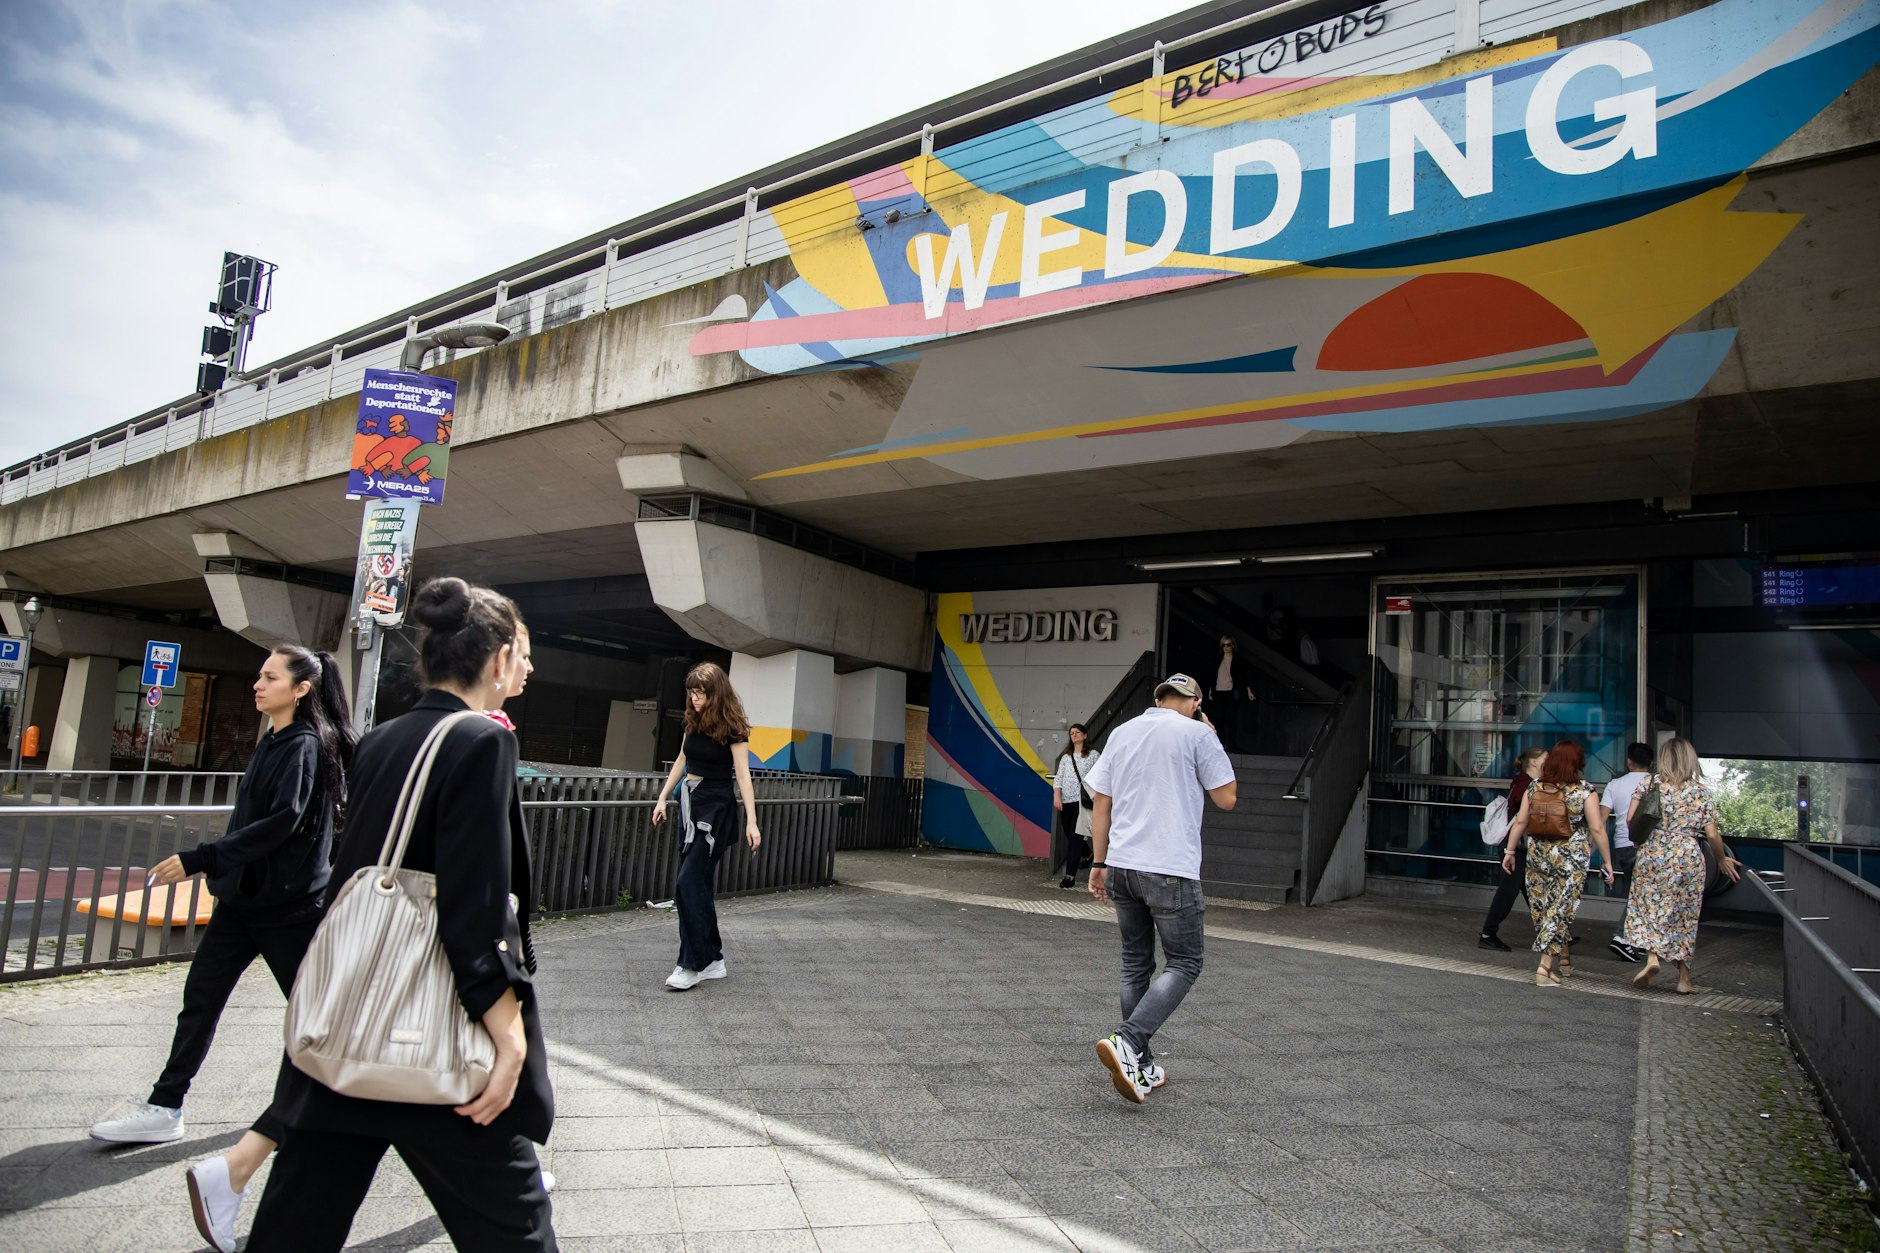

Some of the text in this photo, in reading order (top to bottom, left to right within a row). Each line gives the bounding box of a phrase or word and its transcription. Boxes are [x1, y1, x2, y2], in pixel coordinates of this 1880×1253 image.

[914, 40, 1658, 319] WEDDING
[367, 380, 453, 400] Menschenrechte
[394, 392, 421, 402] statt
[366, 397, 446, 415] Deportationen!
[376, 480, 430, 494] MERA25
[384, 509, 402, 518] NAZIS
[384, 521, 403, 530] KREUZ
[382, 533, 392, 542] DIE
[1779, 570, 1795, 578] Ring
[1779, 579, 1795, 588] Ring
[1779, 588, 1796, 597] Ring
[1780, 597, 1796, 605] Ring
[960, 608, 1118, 643] WEDDING
[2, 642, 15, 657] P
